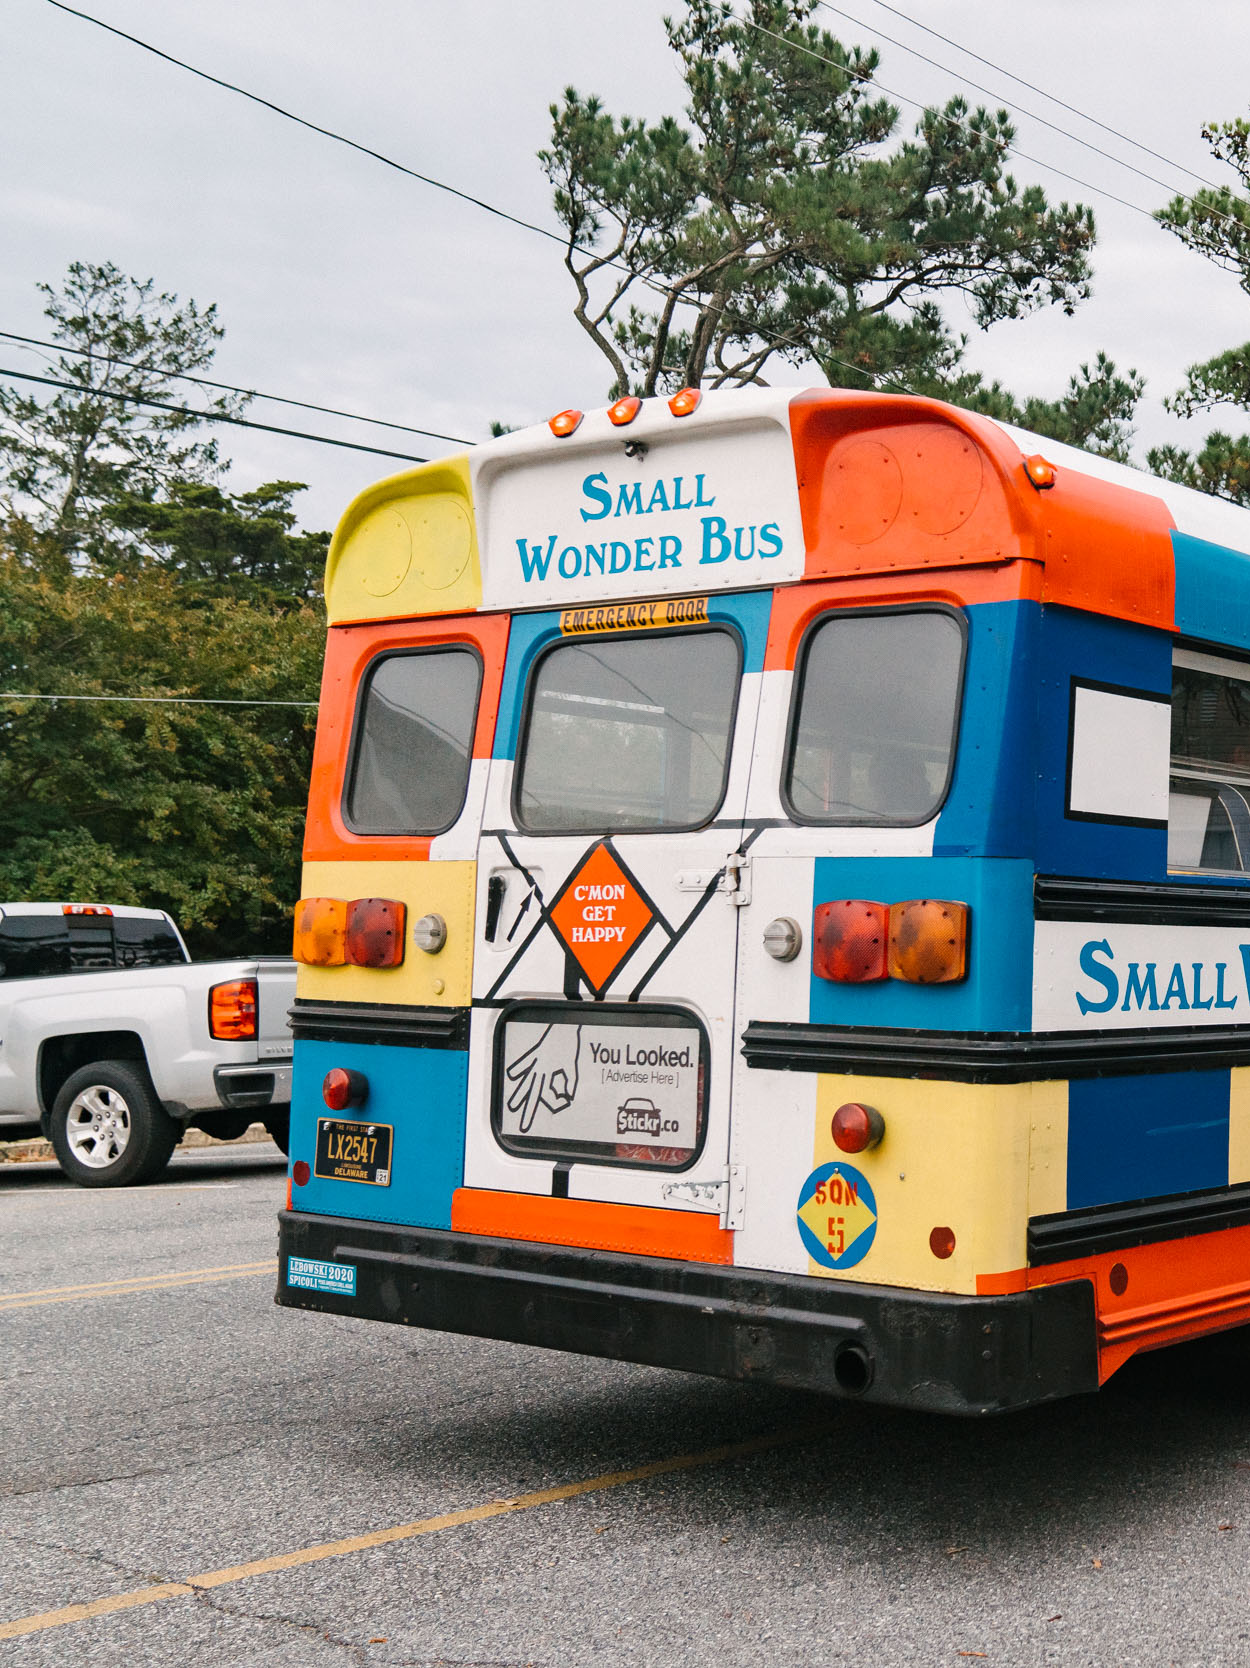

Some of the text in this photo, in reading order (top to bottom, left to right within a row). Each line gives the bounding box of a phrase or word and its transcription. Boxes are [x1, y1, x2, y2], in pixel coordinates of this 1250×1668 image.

[580, 472, 716, 522] SMALL
[516, 516, 783, 583] WONDER BUS
[563, 599, 706, 632] EMERGENCY DOOR
[574, 884, 626, 901] C'MON
[582, 905, 617, 921] GET
[571, 926, 627, 942] HAPPY
[265, 1046, 293, 1054] SILVE
[590, 1042, 694, 1068] You Looked.
[328, 1132, 378, 1164] LX2547
[334, 1167, 369, 1179] DELAWARE
[379, 1174, 387, 1182] 21
[815, 1178, 858, 1206] SQN
[828, 1216, 845, 1254] 5
[289, 1274, 318, 1288] SPICOLI
[290, 1260, 353, 1282] LEBOWSKI 2020
